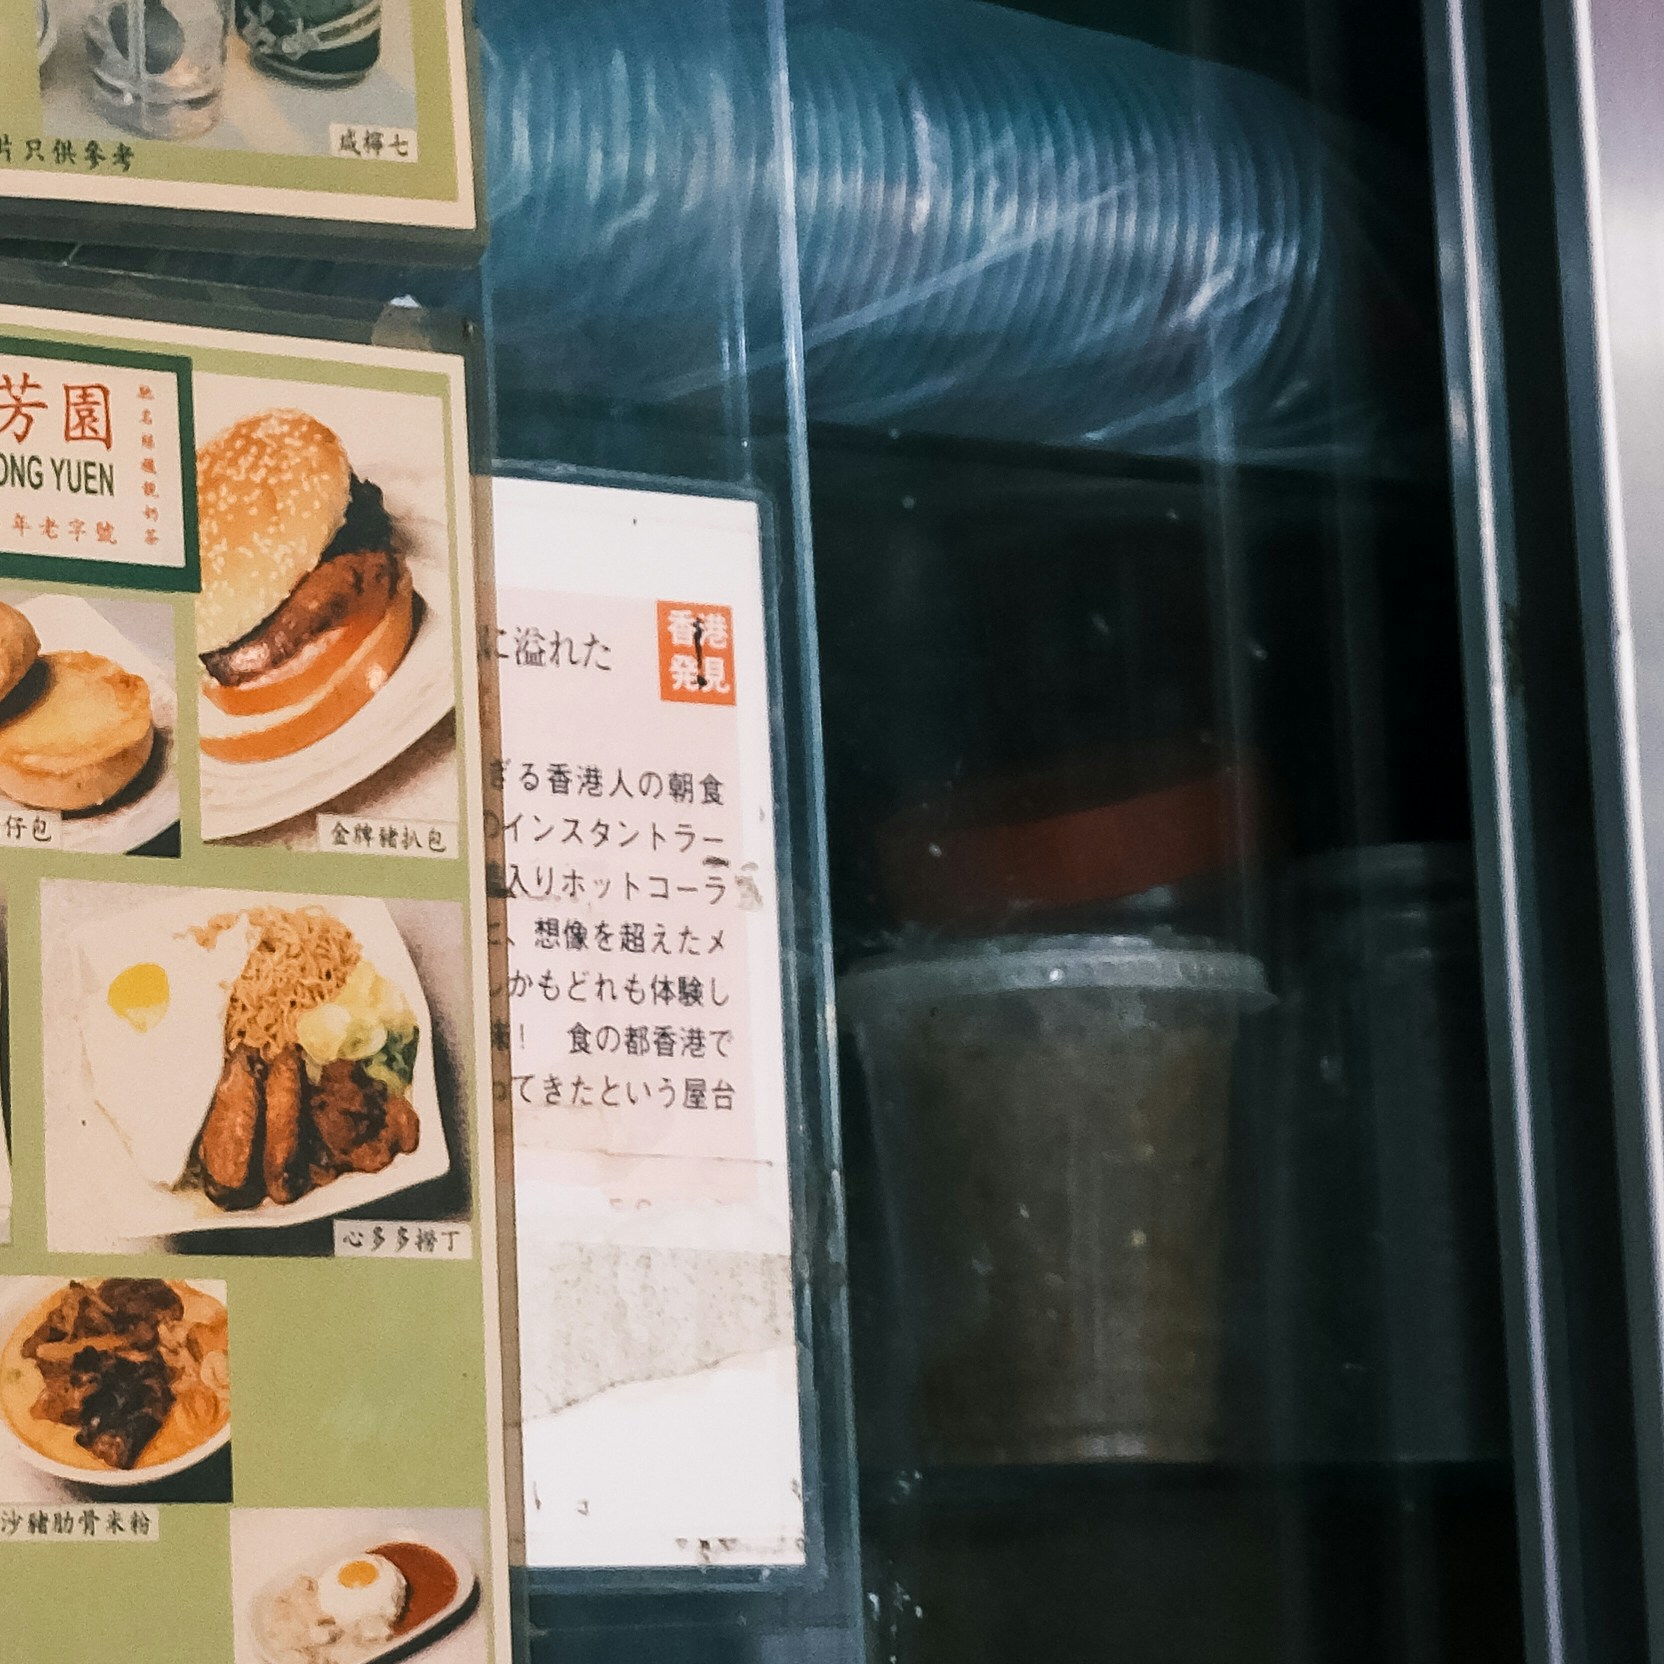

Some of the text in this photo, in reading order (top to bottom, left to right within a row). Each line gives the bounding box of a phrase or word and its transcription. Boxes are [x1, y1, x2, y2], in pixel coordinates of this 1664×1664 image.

[50, 456, 116, 498] YUEN
[668, 609, 728, 649] 香港
[669, 653, 730, 694] 発見
[332, 820, 447, 853] 金牌豬扒包
[486, 863, 727, 906] 入りホットコーラ
[342, 1225, 461, 1253] 心多多撈丁
